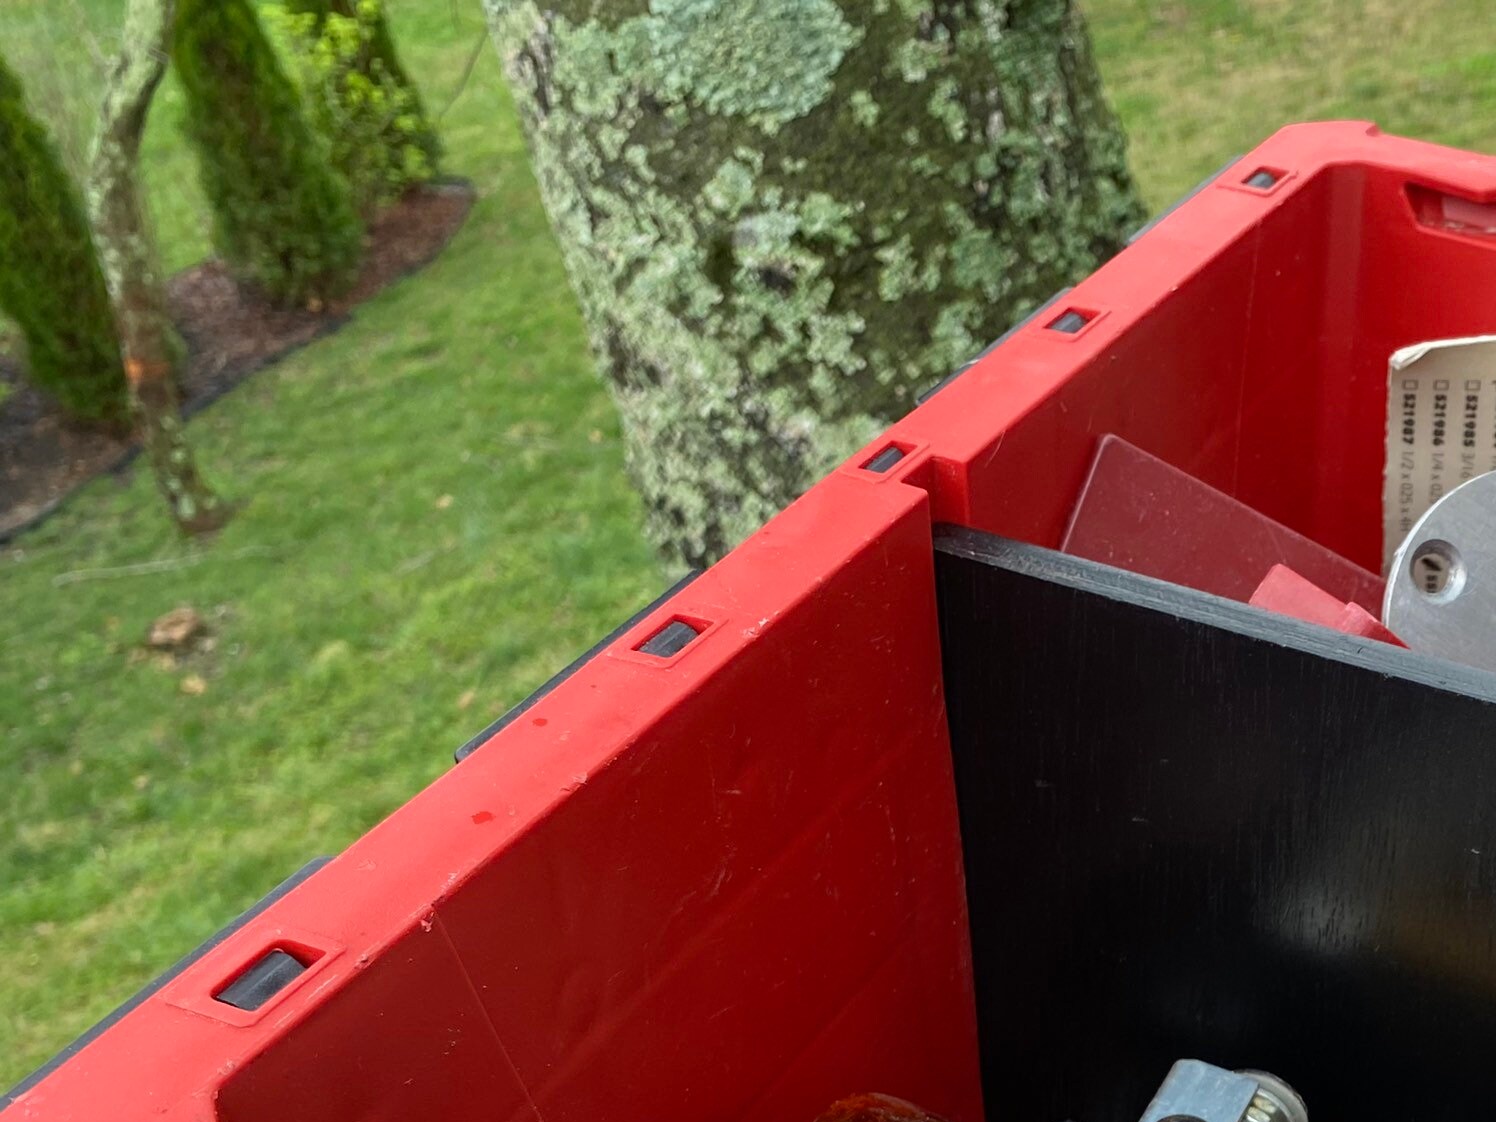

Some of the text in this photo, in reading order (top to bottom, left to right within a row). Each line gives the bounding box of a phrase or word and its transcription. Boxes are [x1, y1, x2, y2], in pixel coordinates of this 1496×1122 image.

[1402, 393, 1417, 445] 521987
[1432, 393, 1448, 446] 521986
[1463, 394, 1479, 448] 521985
